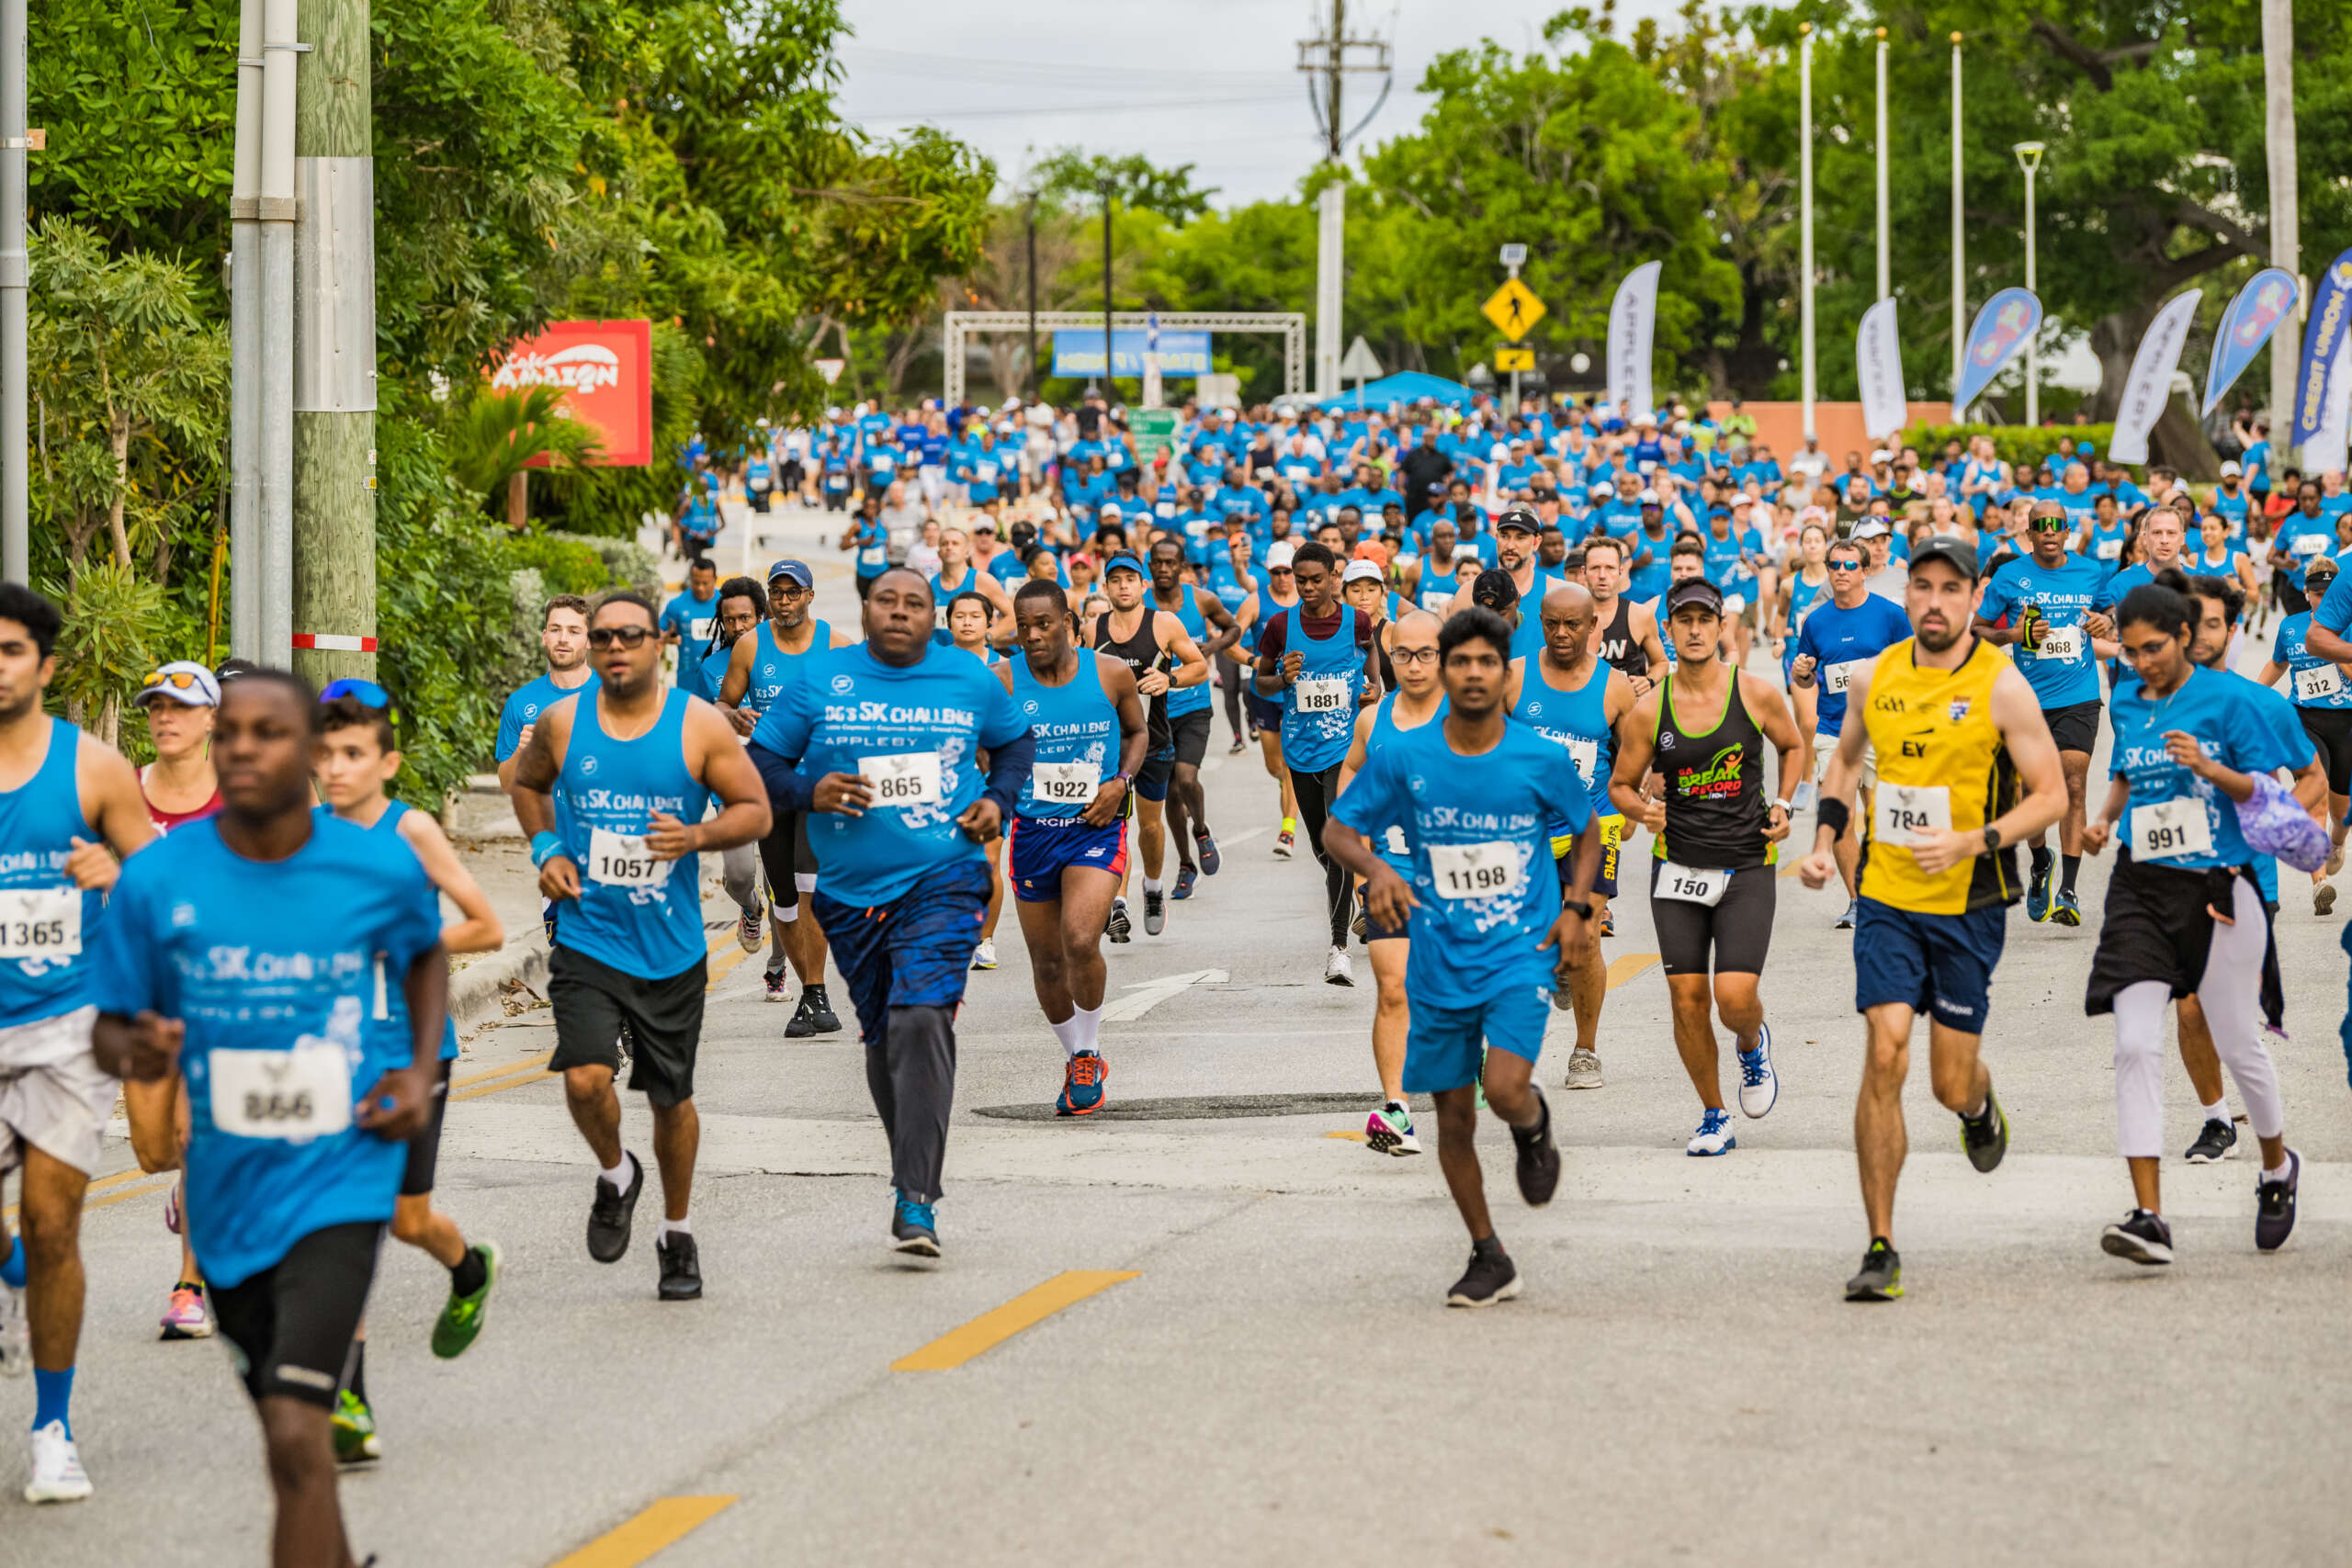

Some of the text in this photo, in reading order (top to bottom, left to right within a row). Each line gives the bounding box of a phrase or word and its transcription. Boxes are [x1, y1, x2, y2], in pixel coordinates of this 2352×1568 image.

[492, 364, 619, 394] AMAZON
[2301, 357, 2326, 431] CREDIT
[2046, 641, 2072, 655] 968
[1835, 675, 1850, 689] 56
[2307, 680, 2332, 695] 312
[1305, 694, 1340, 708] 1881
[825, 737, 918, 748] APPLEBY
[1902, 740, 1927, 758] EY
[1679, 763, 1743, 788] BREAK
[881, 776, 922, 798] 865
[1044, 780, 1088, 798] 1922
[1690, 779, 1743, 796] RECORD
[1890, 808, 1928, 830] 784
[2147, 826, 2186, 851] 991
[601, 854, 656, 879] 1057
[1448, 865, 1507, 890] 1198
[1673, 877, 1709, 897] 150
[0, 919, 64, 947] 1365
